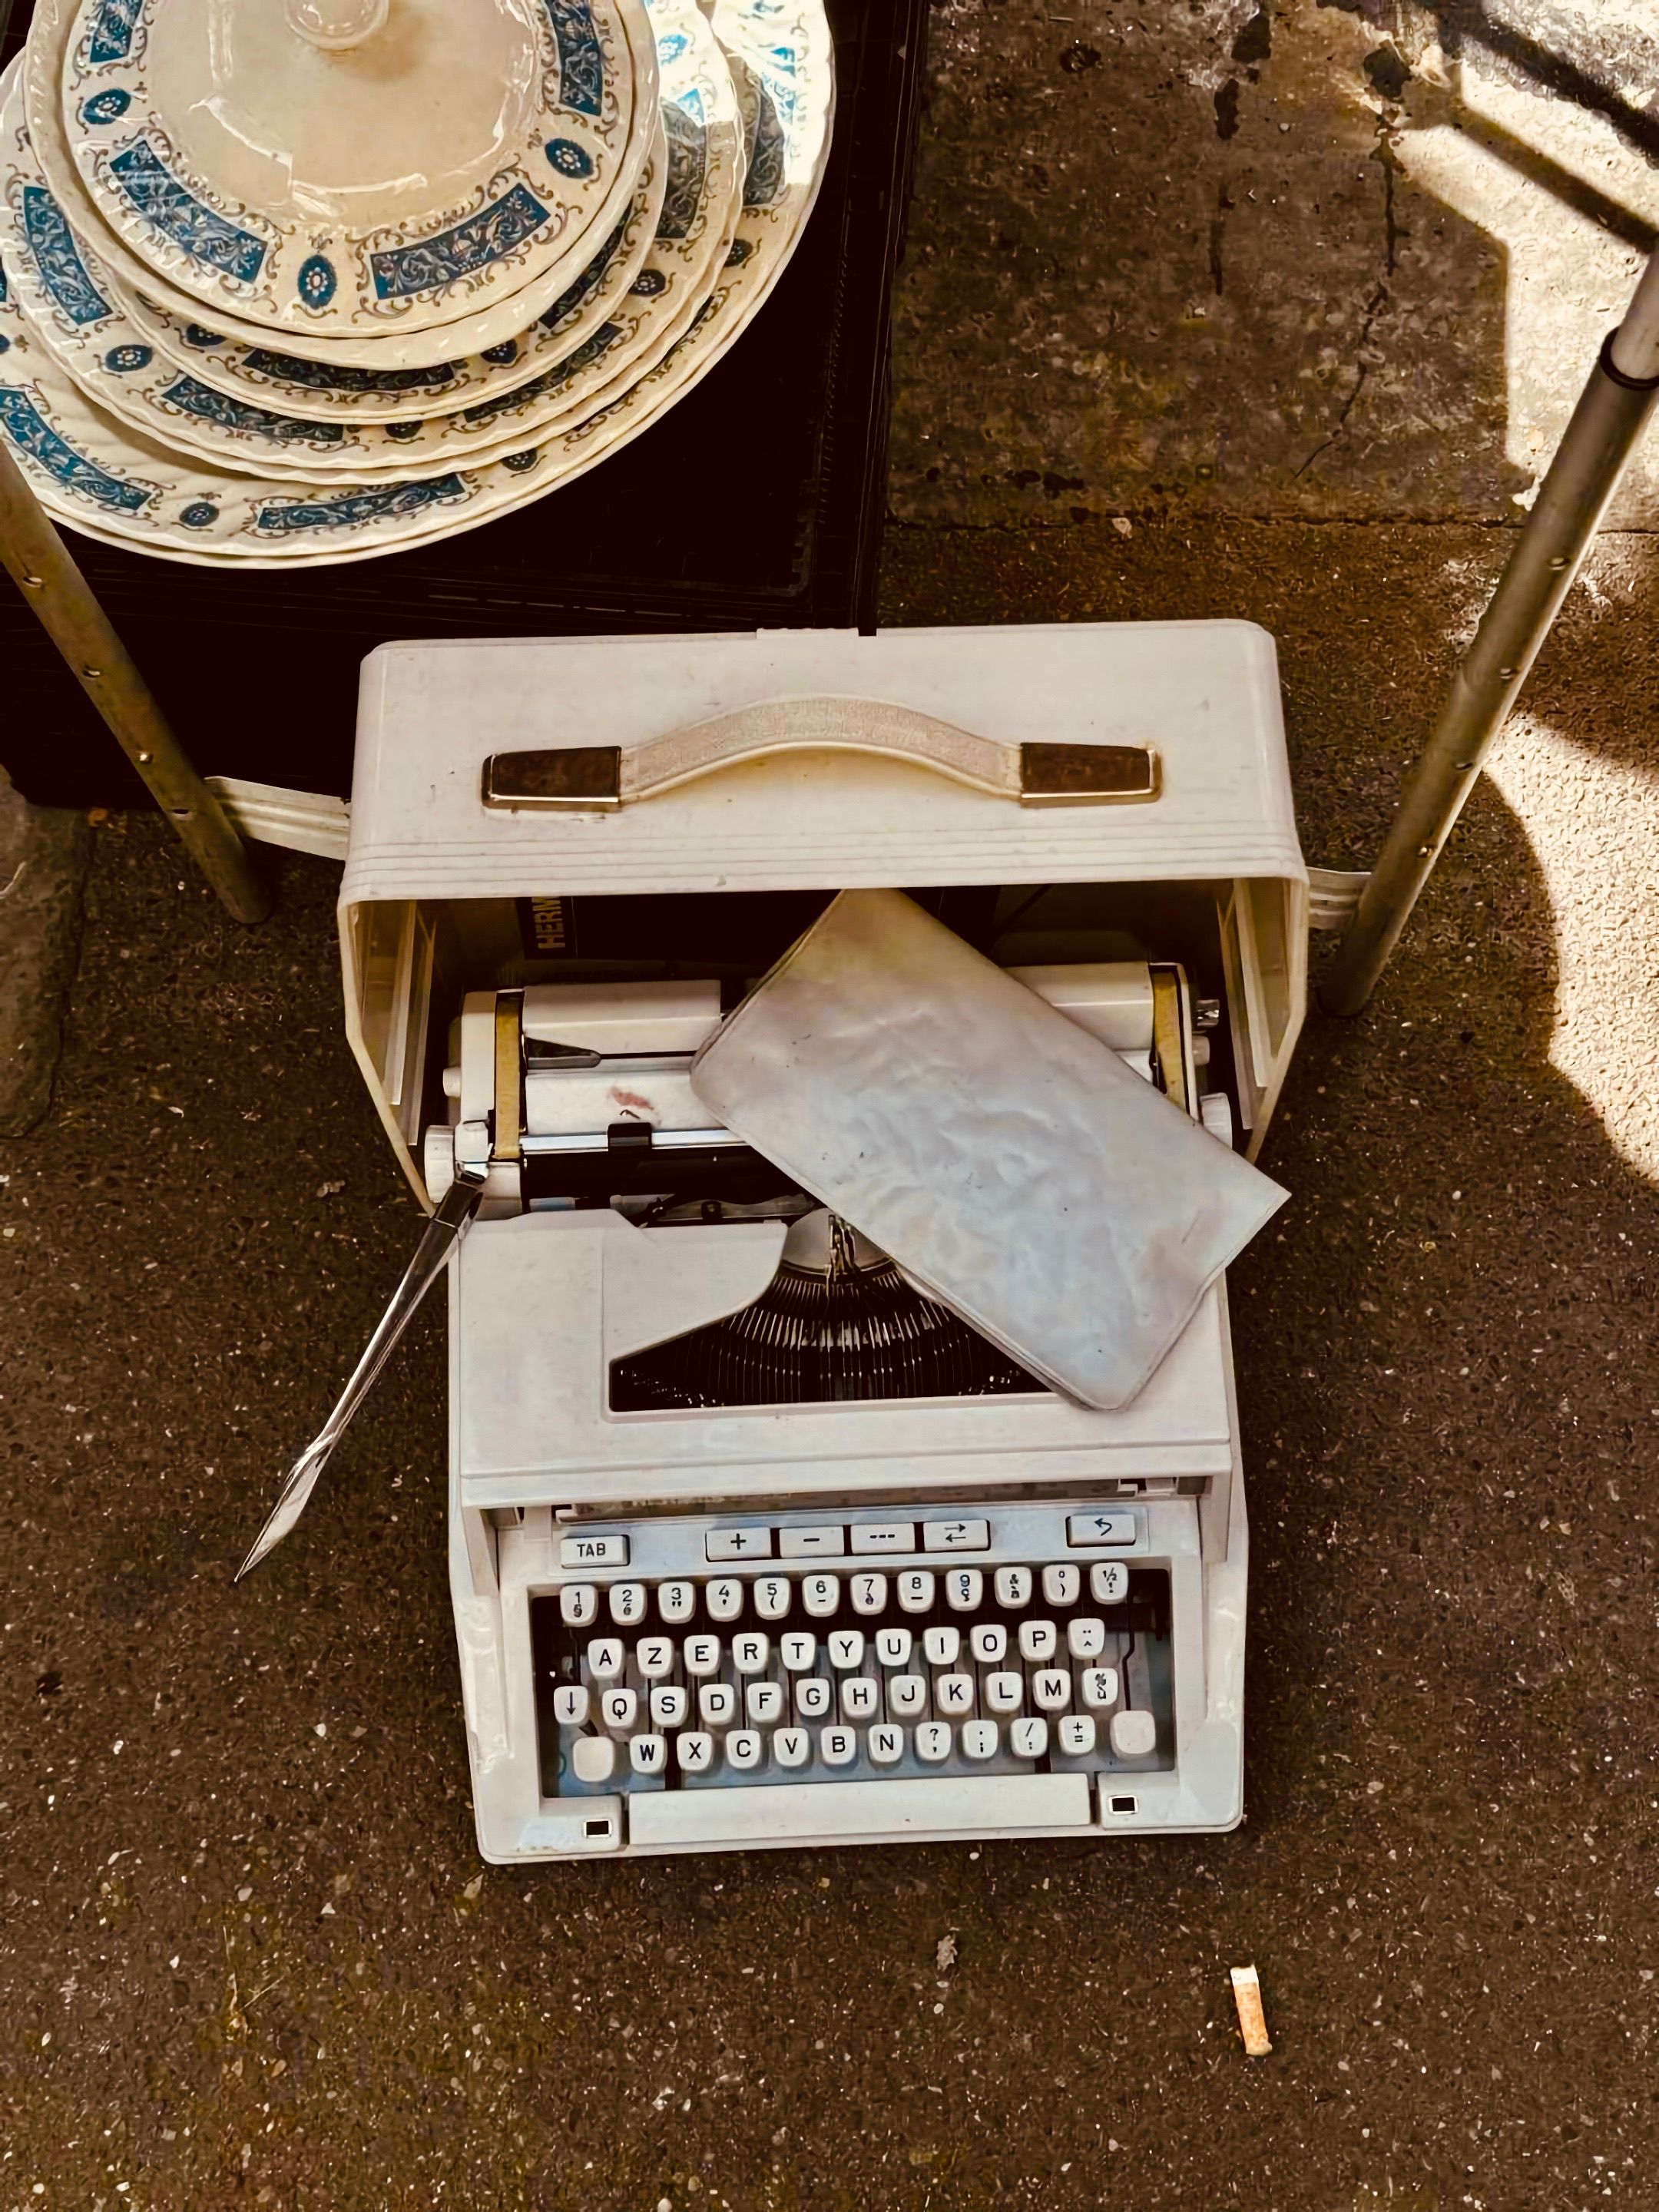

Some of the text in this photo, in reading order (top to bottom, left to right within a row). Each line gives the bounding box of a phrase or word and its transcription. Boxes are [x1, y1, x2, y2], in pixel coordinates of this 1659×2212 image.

[576, 1542, 606, 1558] TAB
[575, 1591, 581, 1604] 1
[622, 1589, 632, 1602] 2
[671, 1587, 682, 1601] 3
[718, 1584, 730, 1598] 4
[767, 1582, 778, 1596] 5
[816, 1580, 826, 1594] 6
[863, 1578, 874, 1592] 7
[911, 1576, 922, 1590] 8
[959, 1574, 971, 1588] 9
[598, 1648, 612, 1667] A
[647, 1647, 662, 1665] Z
[694, 1644, 710, 1662] E
[743, 1642, 758, 1661] R
[790, 1642, 805, 1660] T
[839, 1640, 853, 1657] Y
[887, 1638, 901, 1655] U
[940, 1637, 945, 1654] I
[982, 1634, 998, 1653] O
[1032, 1630, 1047, 1647] P
[612, 1697, 628, 1720] Q
[661, 1695, 676, 1714] S
[710, 1694, 725, 1711] D
[759, 1691, 773, 1710] F
[806, 1687, 821, 1706] G
[853, 1687, 868, 1705] H
[901, 1684, 916, 1702] J
[949, 1684, 963, 1701] K
[998, 1681, 1014, 1699] L
[1045, 1679, 1061, 1697] M
[639, 1743, 655, 1762] W
[688, 1741, 702, 1760] X
[736, 1739, 751, 1758] C
[784, 1737, 798, 1755] V
[832, 1736, 846, 1753] B
[879, 1734, 894, 1751] N
